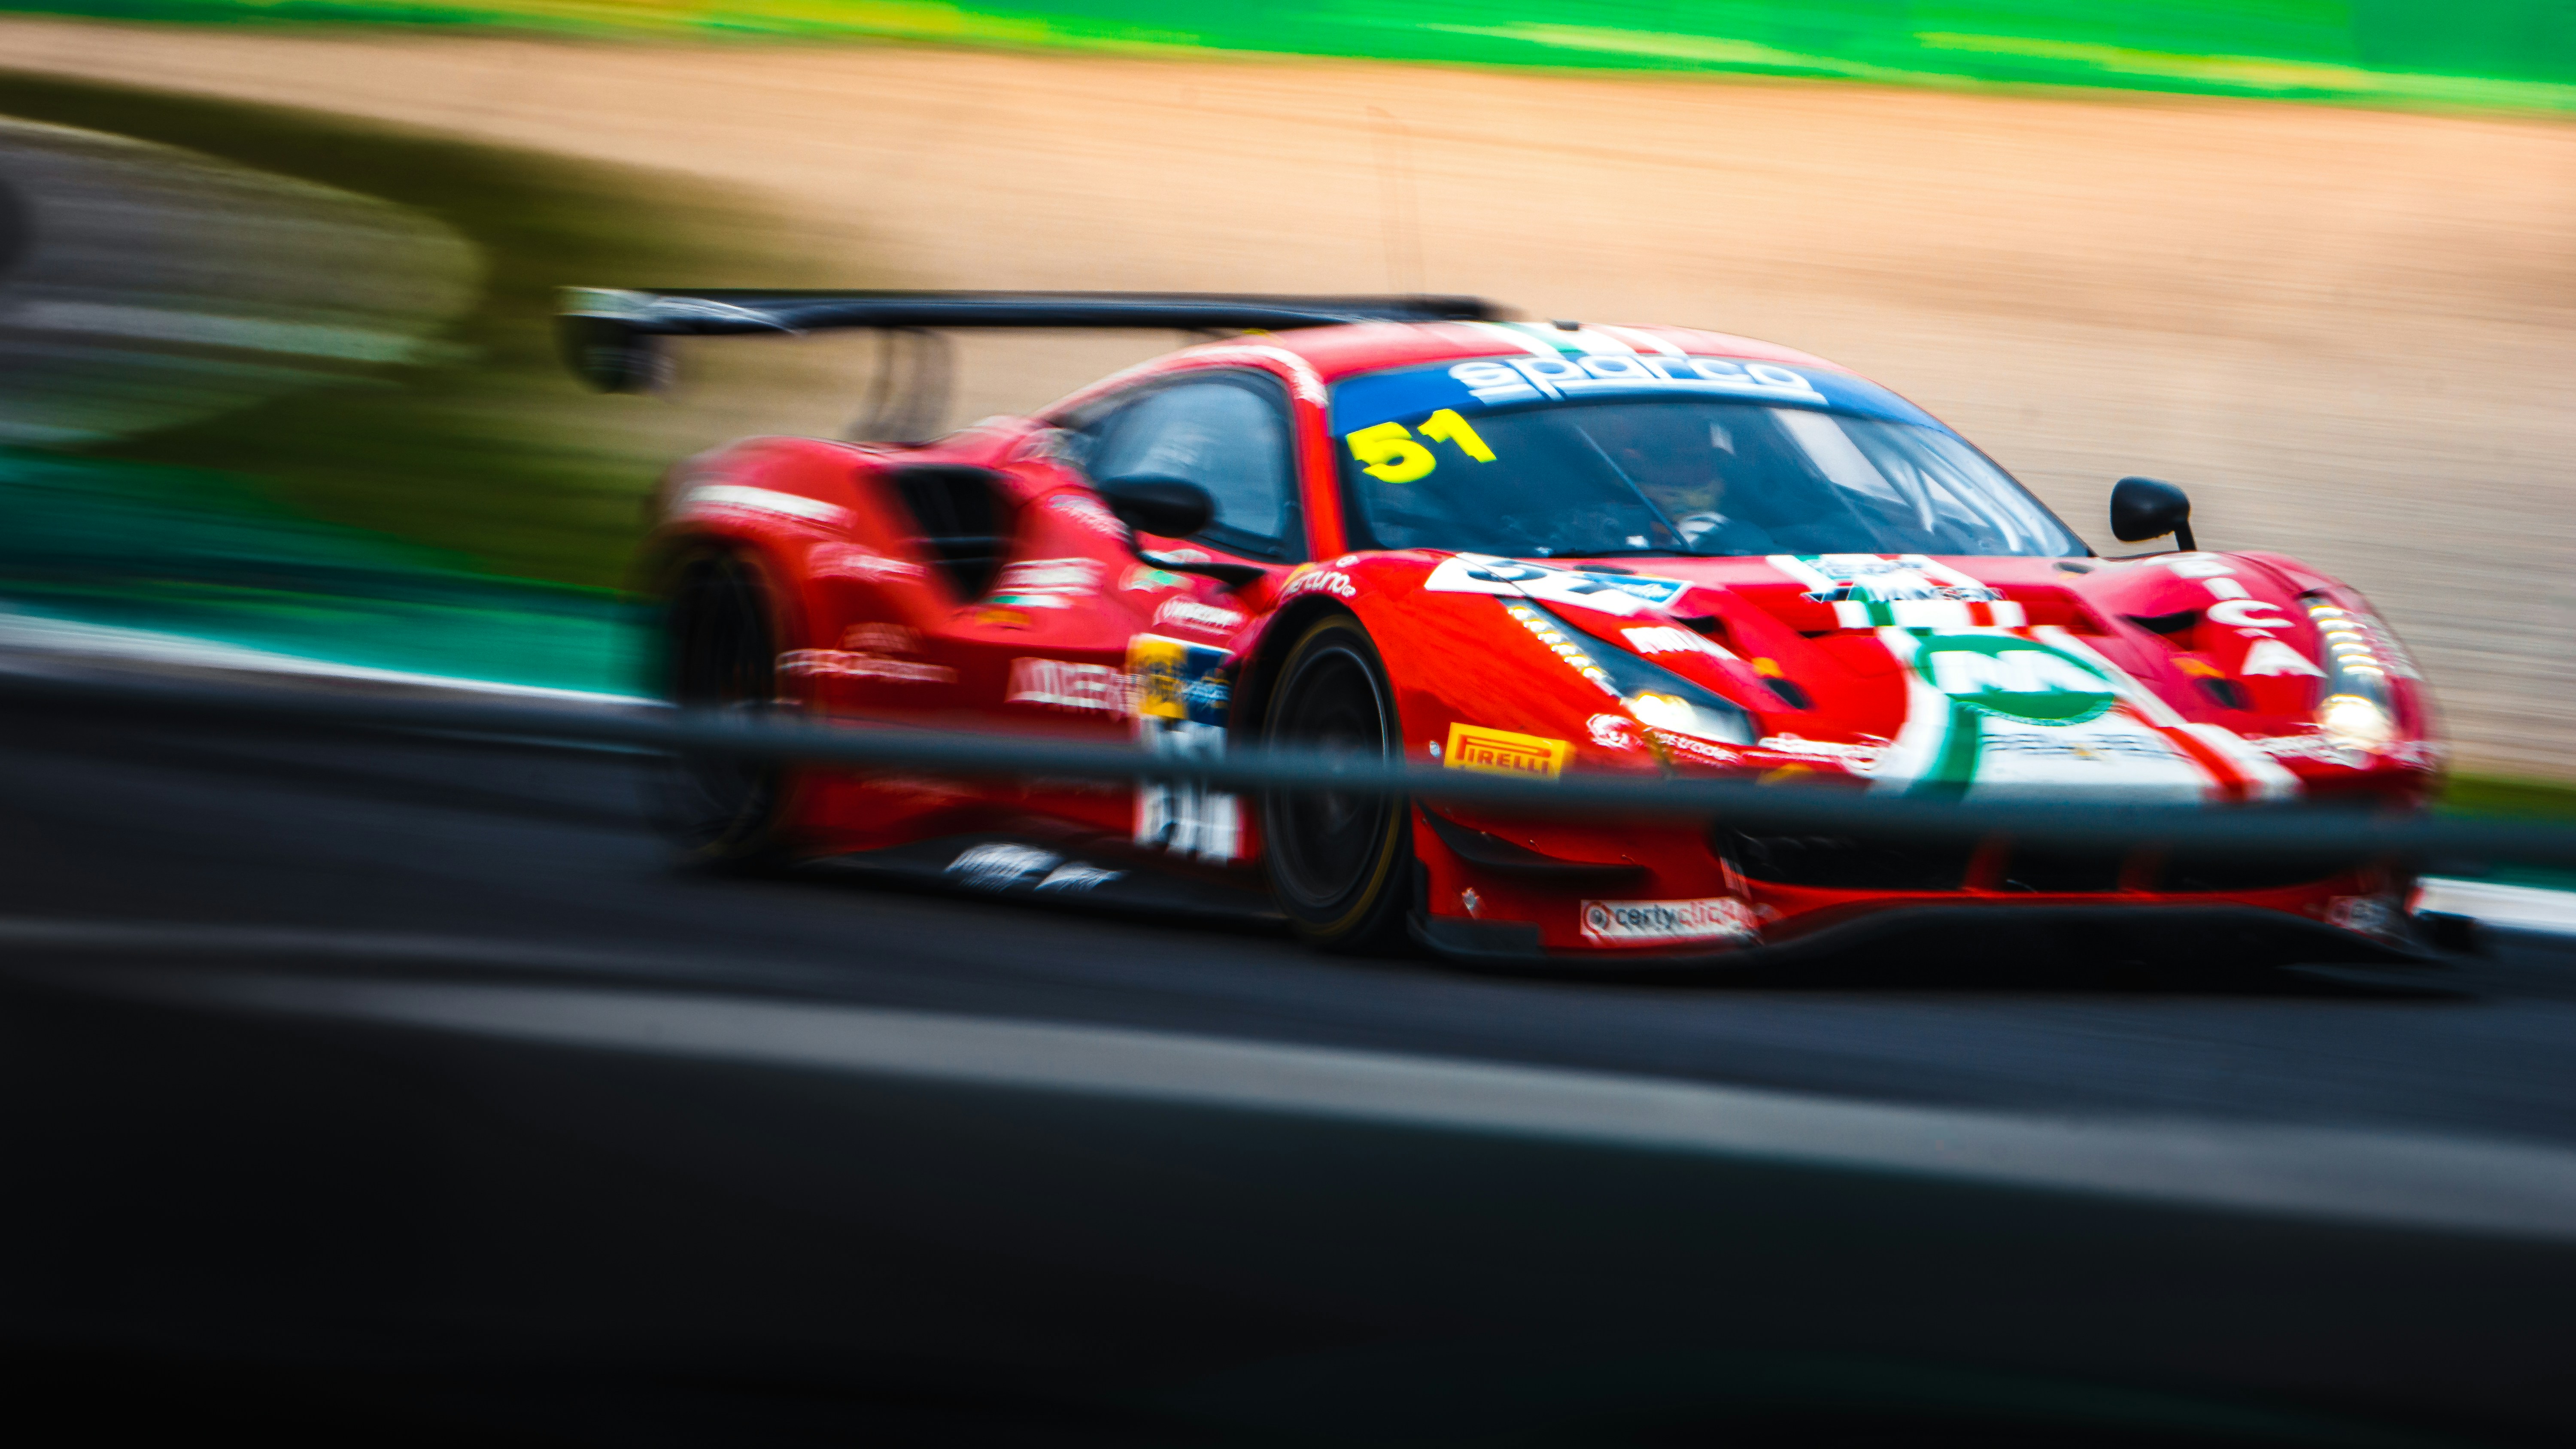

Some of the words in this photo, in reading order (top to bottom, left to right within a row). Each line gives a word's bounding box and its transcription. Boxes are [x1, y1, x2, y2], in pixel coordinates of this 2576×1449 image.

[1449, 355, 1817, 402] sparco
[1346, 408, 1496, 483] 51
[1455, 734, 1552, 775] PIRELLI
